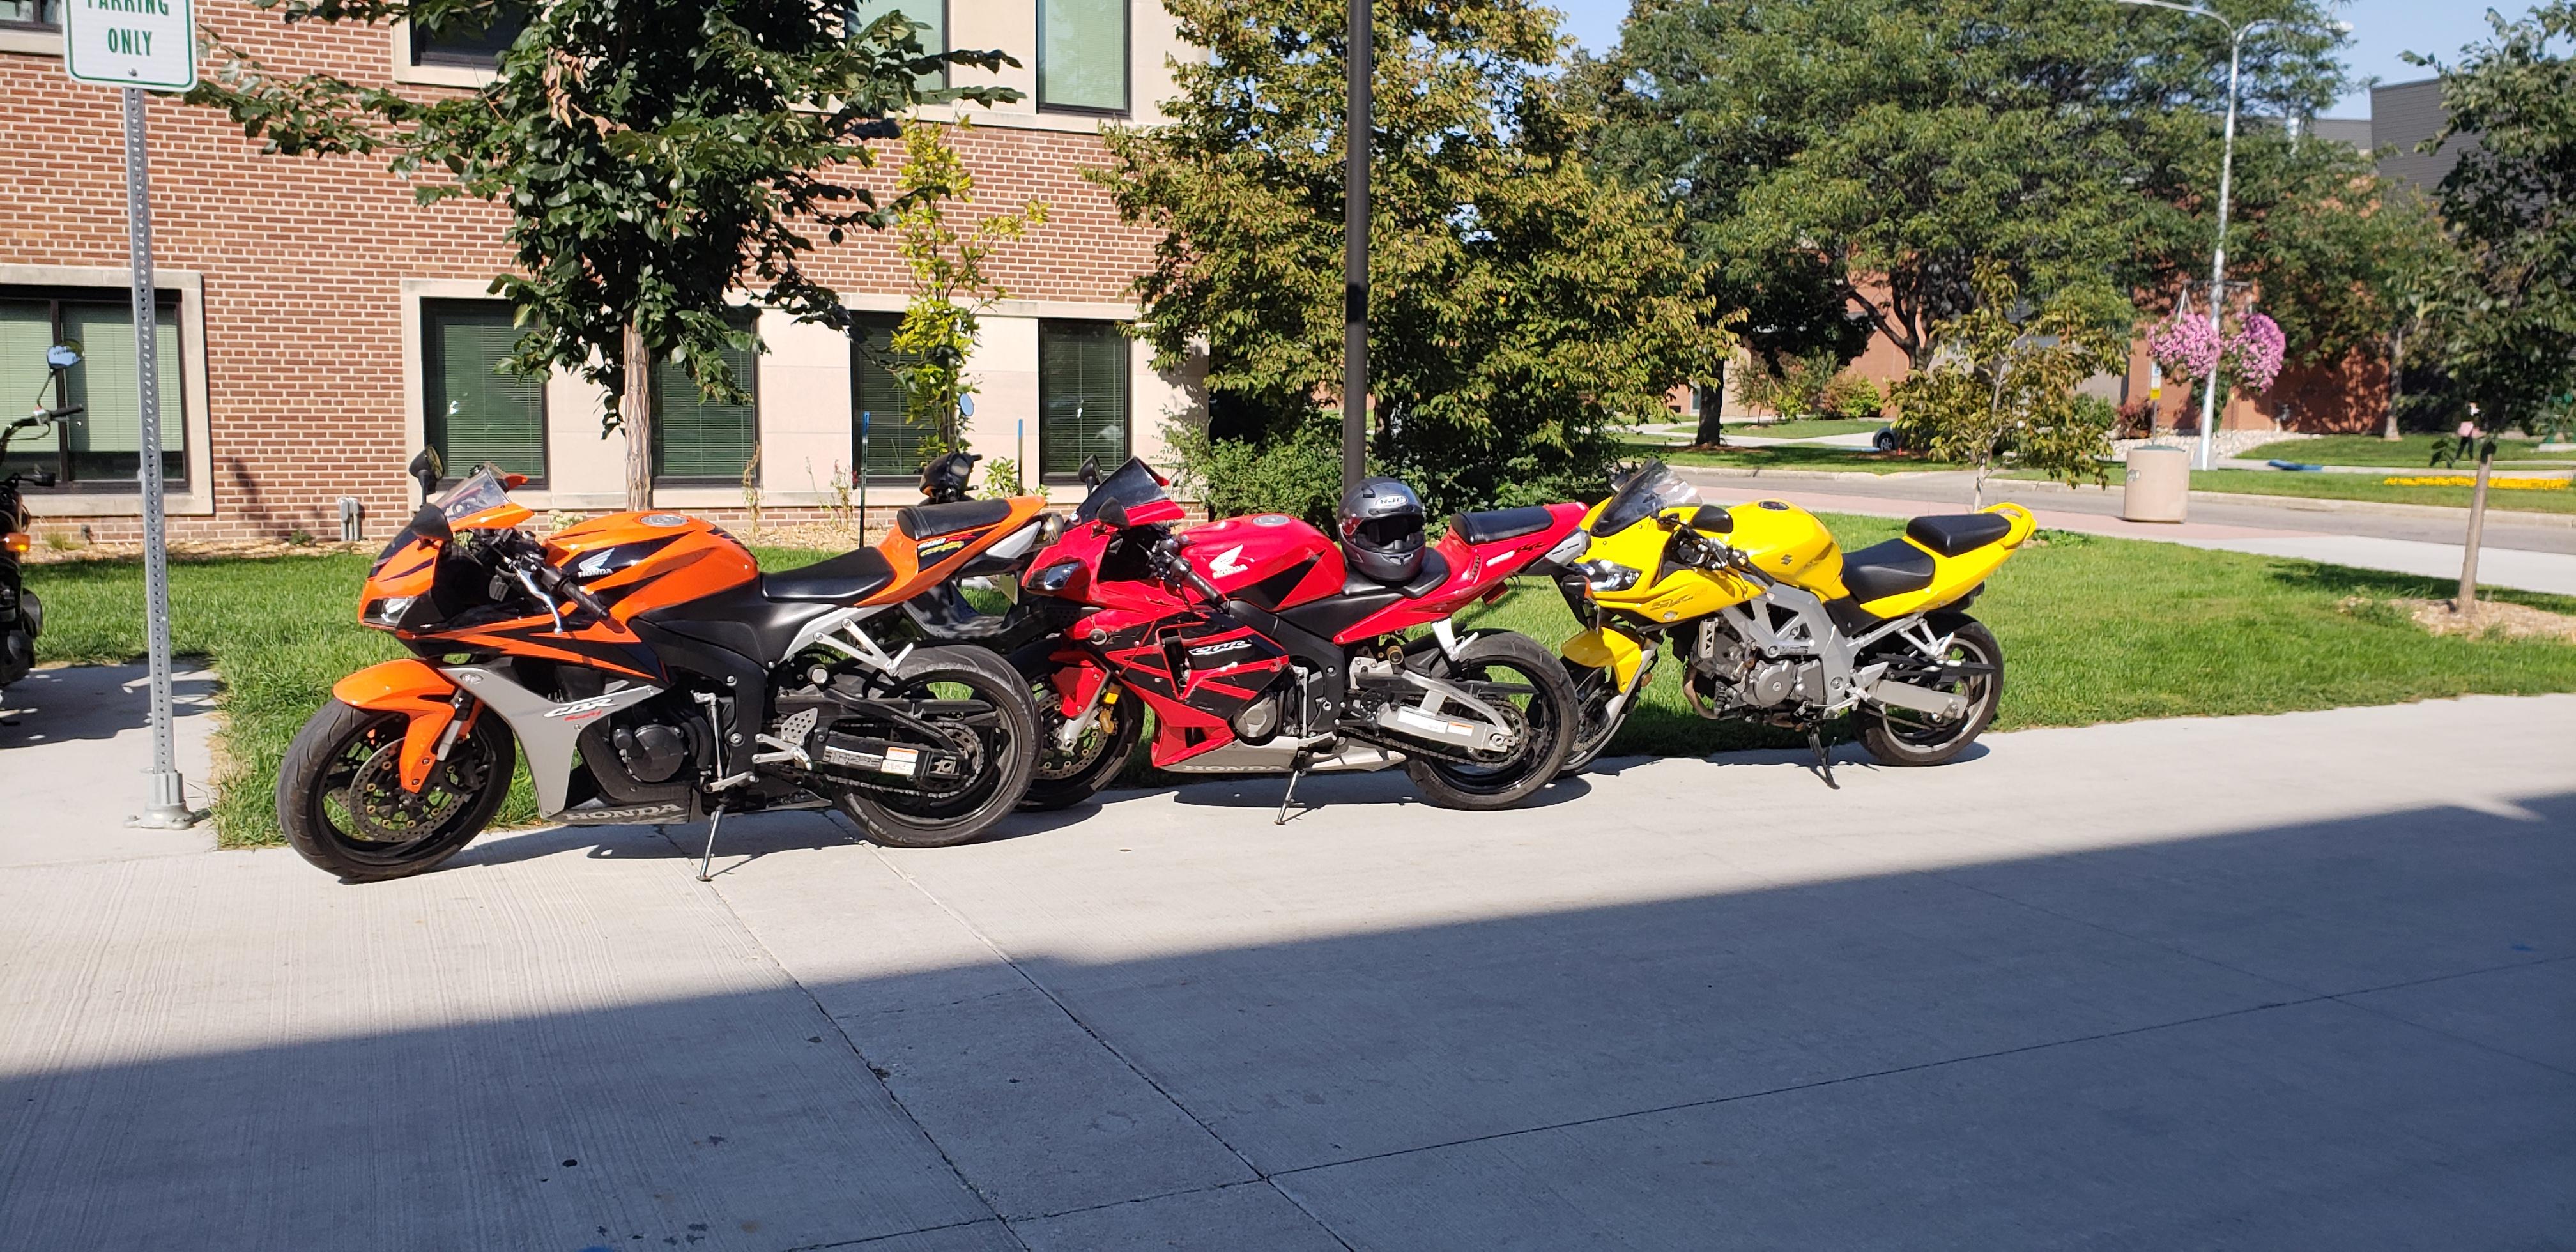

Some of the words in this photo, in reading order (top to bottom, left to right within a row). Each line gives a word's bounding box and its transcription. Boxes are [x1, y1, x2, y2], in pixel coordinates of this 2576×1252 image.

[108, 28, 153, 56] ONLY
[578, 568, 613, 577] HONDA
[1212, 564, 1248, 579] HONDA
[543, 698, 620, 717] CBR
[565, 804, 685, 820] HONDA
